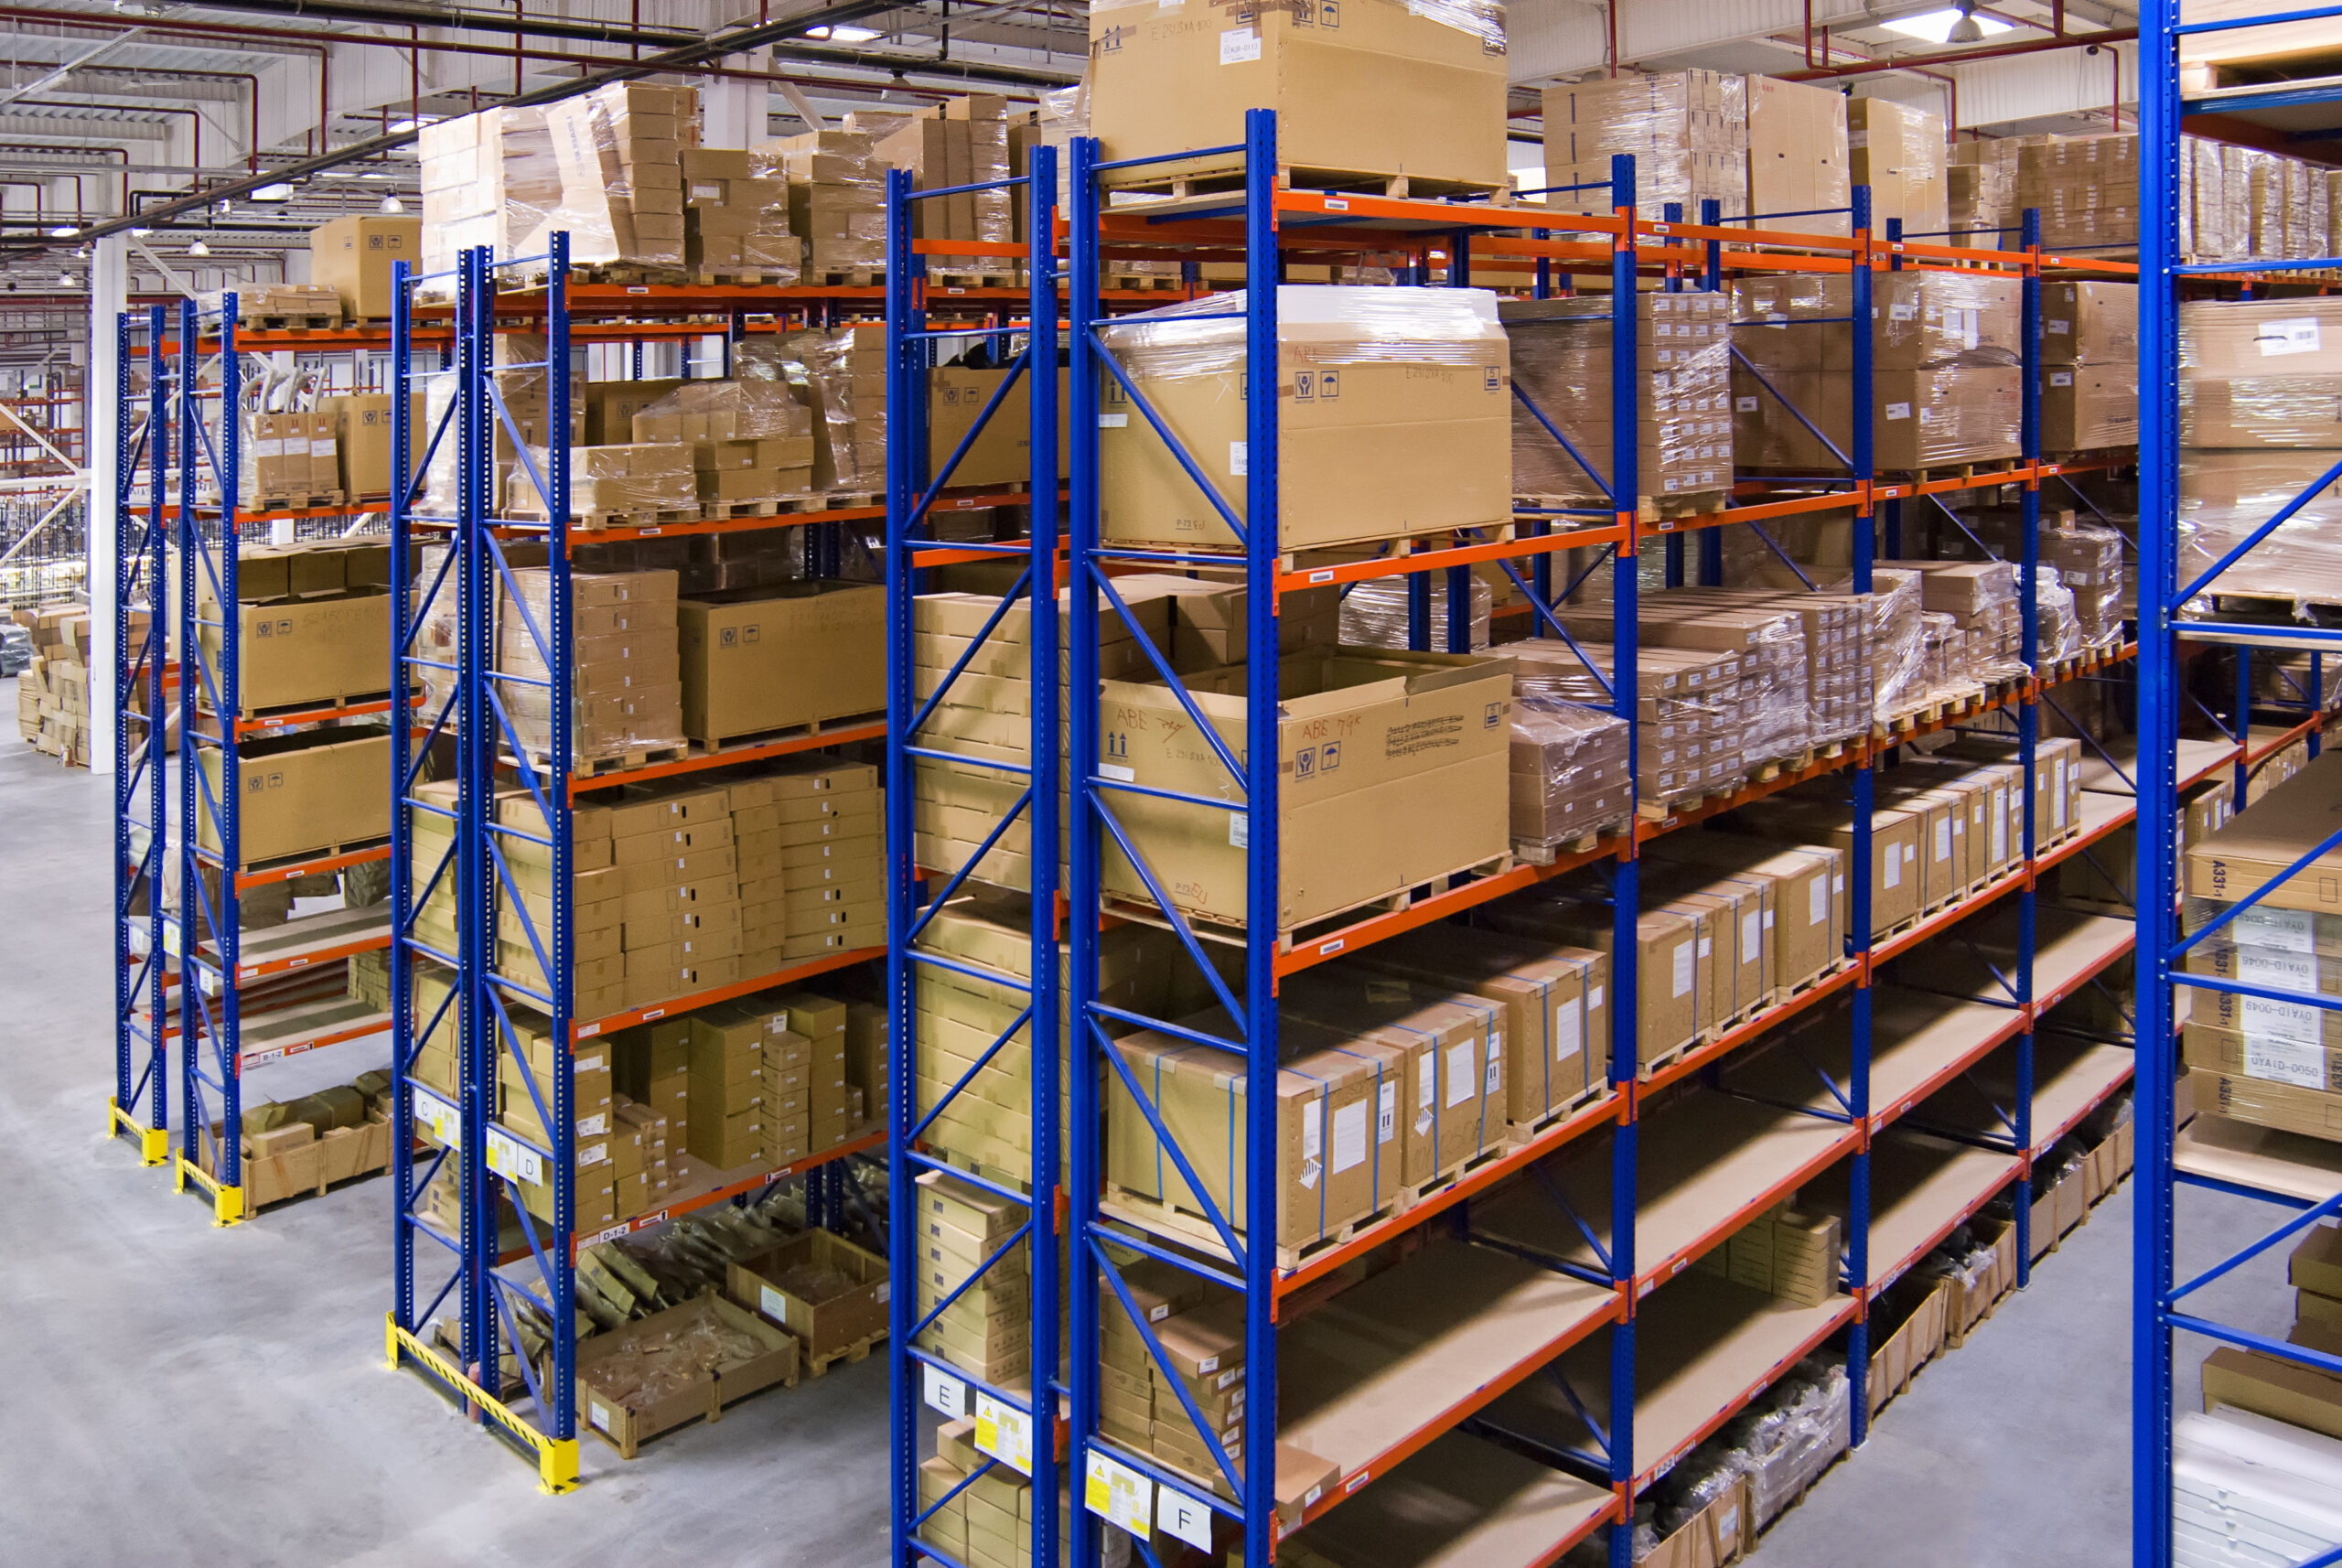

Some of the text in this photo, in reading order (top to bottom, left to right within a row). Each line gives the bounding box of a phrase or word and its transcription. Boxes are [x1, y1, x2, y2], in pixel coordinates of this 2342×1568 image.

[1116, 708, 1149, 732] ABE
[1302, 719, 1329, 740] ABE
[421, 1101, 429, 1117] C
[525, 1158, 534, 1176] D
[603, 1227, 626, 1240] D-1-2
[939, 1384, 951, 1408] E
[1178, 1508, 1192, 1530] F
